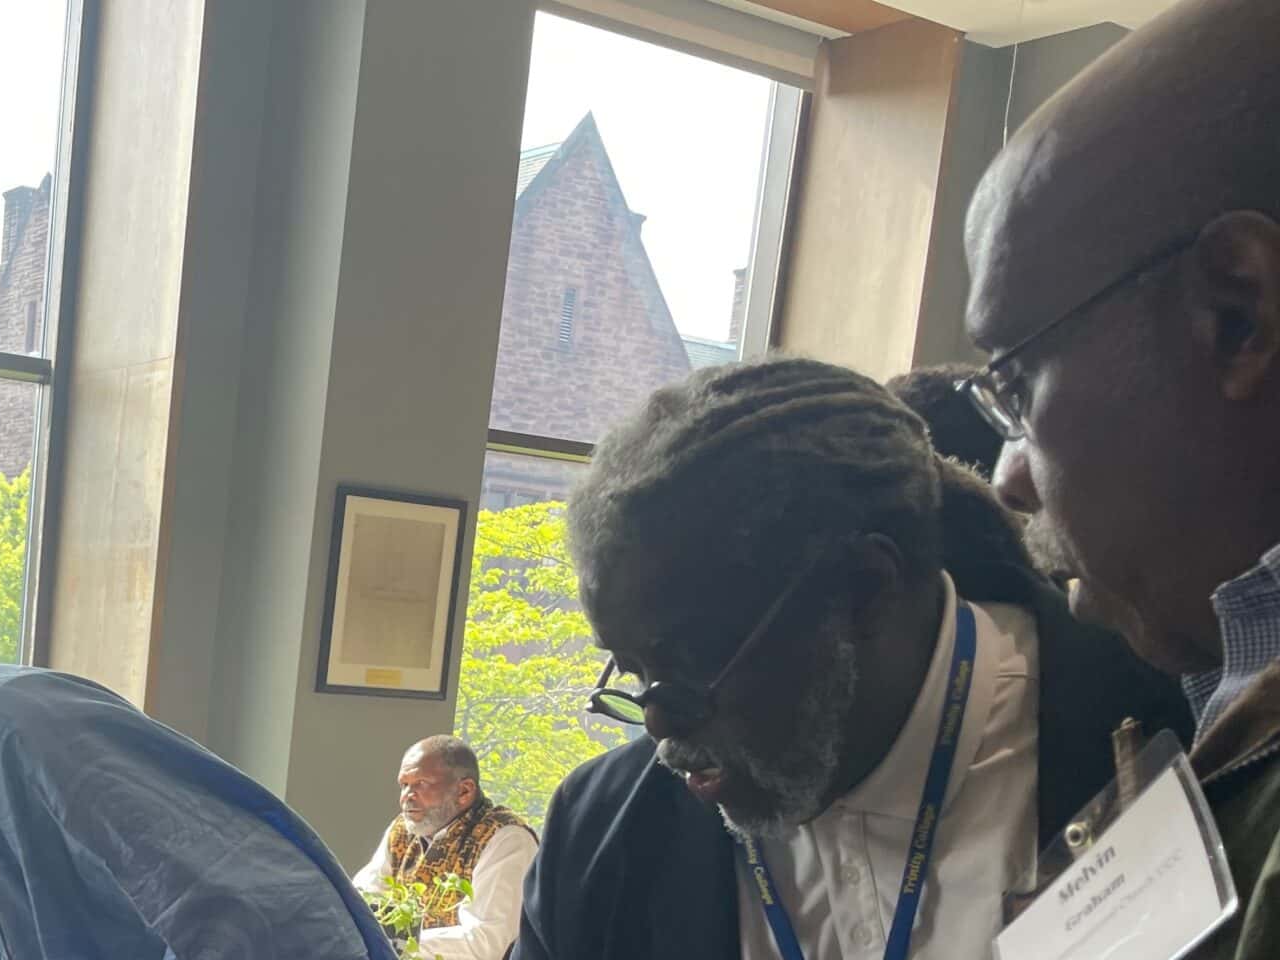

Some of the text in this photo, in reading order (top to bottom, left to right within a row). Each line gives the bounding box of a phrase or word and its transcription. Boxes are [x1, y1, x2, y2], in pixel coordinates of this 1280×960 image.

[753, 866, 774, 905] College
[904, 853, 925, 894] Trinity
[1058, 846, 1116, 904] Melvin
[1064, 873, 1126, 932] Graham
